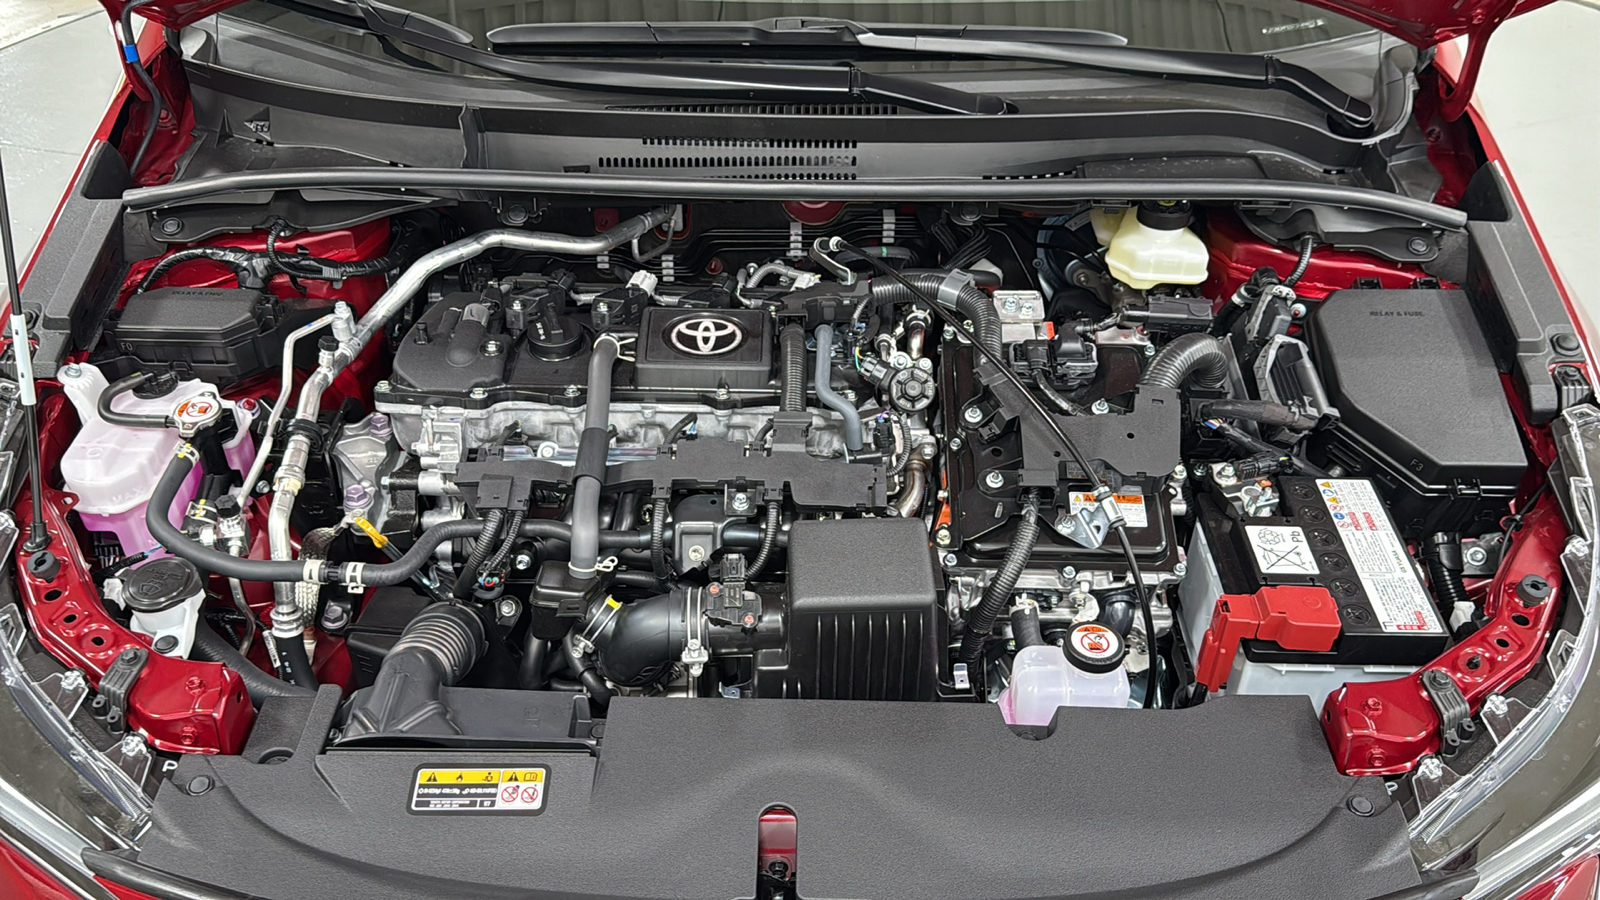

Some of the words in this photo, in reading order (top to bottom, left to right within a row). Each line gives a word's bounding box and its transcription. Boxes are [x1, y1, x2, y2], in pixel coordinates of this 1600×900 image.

[1409, 458, 1424, 472] F3
[1289, 530, 1304, 543] Pb
[162, 760, 178, 772] P
